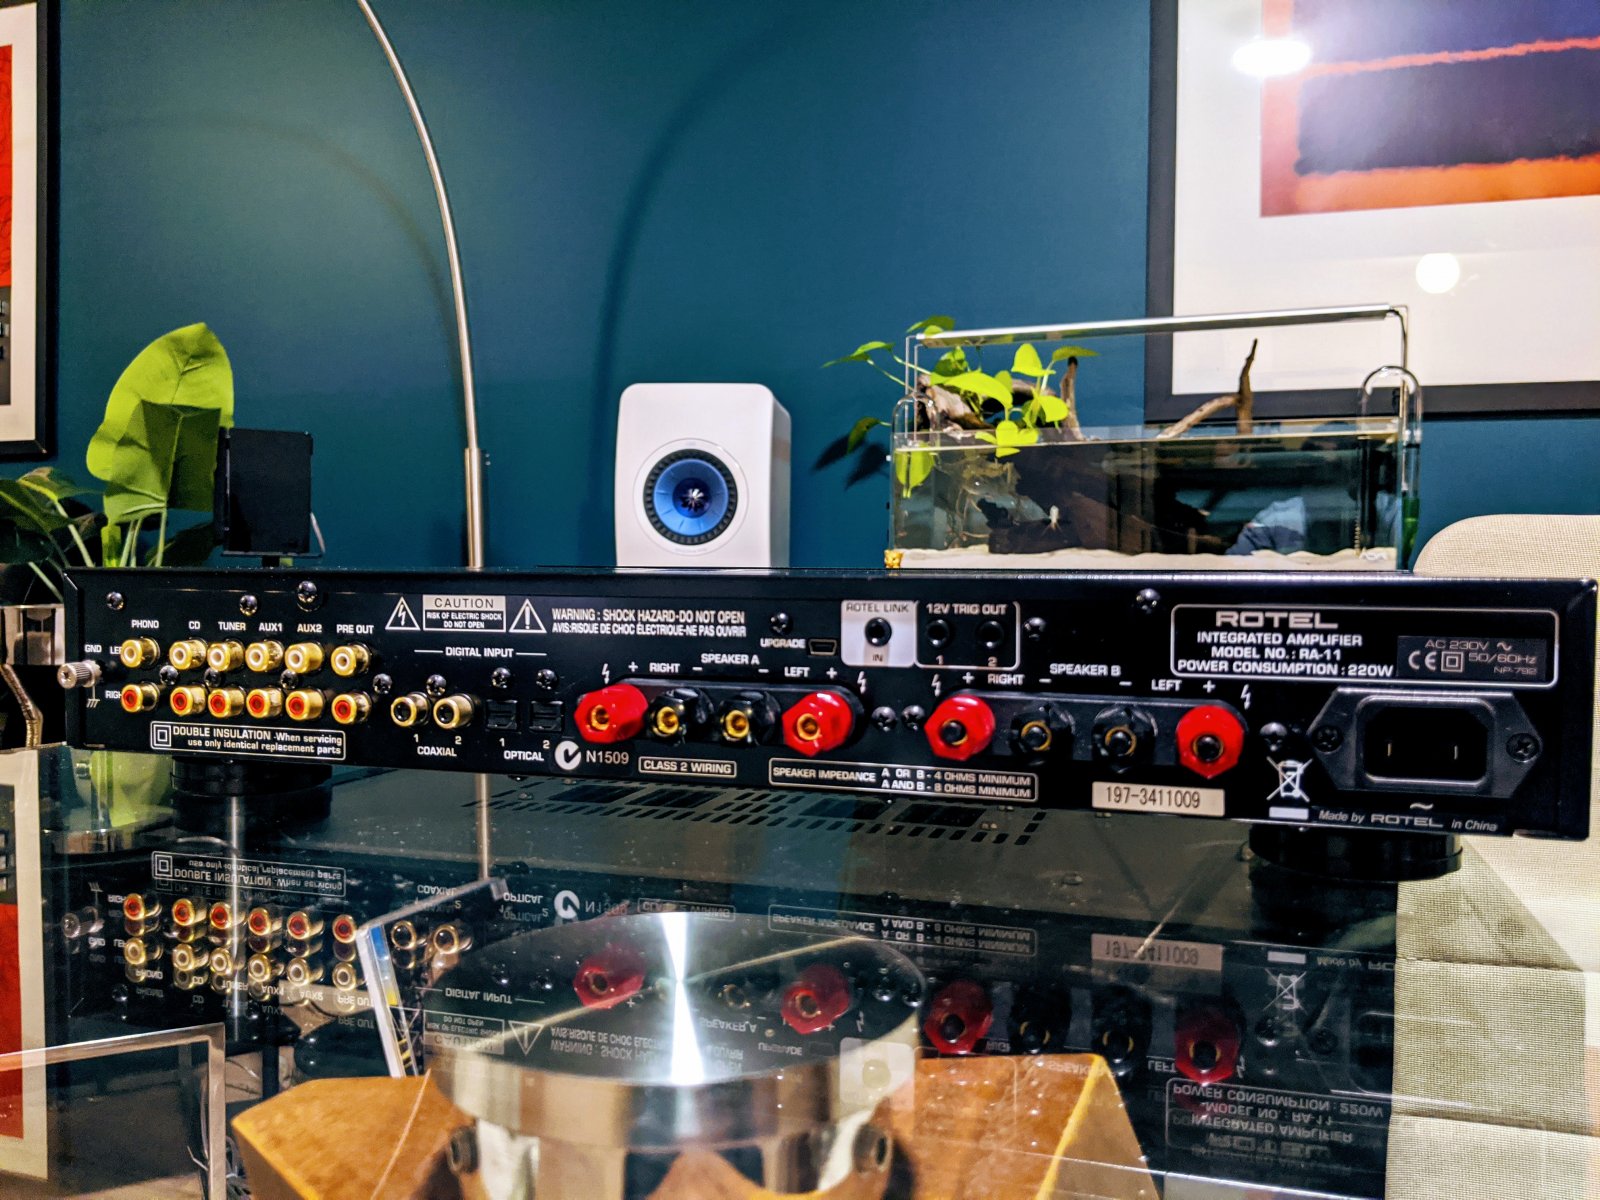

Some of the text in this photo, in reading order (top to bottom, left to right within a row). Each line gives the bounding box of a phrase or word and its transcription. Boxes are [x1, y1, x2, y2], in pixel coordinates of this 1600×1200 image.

[434, 598, 494, 609] CAUTION
[846, 603, 910, 613] ROTEL LINK
[552, 608, 596, 620] WARNING
[603, 609, 635, 622] SHOCK
[696, 610, 716, 624] NOT
[718, 611, 744, 624] OPEN
[926, 604, 1008, 616] 12V TRIG OUT
[426, 612, 502, 621] RISK OF ELECTRIC SHOCK
[1216, 610, 1338, 629] ROTEL
[131, 620, 160, 630] PHONO
[188, 620, 200, 630] CD
[218, 621, 246, 632] TUNER
[258, 622, 282, 632] AUX1
[297, 623, 322, 633] AUX2
[336, 624, 374, 634] PRE OUT
[467, 621, 484, 629] OPEN
[600, 623, 610, 634] DE
[612, 624, 635, 635] CHOC
[698, 625, 714, 636] PAS
[716, 625, 746, 638] OUVRIR
[760, 638, 806, 649] UPGRADE
[1197, 631, 1362, 646] INTEGRATED AMPLIFIER
[1424, 639, 1490, 650] AC 230V
[84, 644, 102, 653] GND
[445, 646, 514, 658] DIGITAL INPUT
[1211, 646, 1260, 659] MODEL
[1300, 648, 1342, 661] RA-11
[701, 653, 760, 665] SPEAKER A
[872, 654, 884, 663] IN
[936, 655, 944, 666] 1
[988, 656, 998, 668] 2
[1468, 652, 1538, 664] 50/60Hz
[649, 662, 680, 673] RIGHT
[784, 666, 810, 678] LEFT
[1050, 663, 1122, 676] SPEAKER B
[1178, 659, 1229, 672] POWER
[1232, 661, 1338, 676] CONSUMPTION
[1348, 664, 1394, 677] 220W
[987, 674, 1025, 686] RIGHT
[1152, 679, 1182, 692] LEFT
[173, 726, 210, 737] DOUBLE
[213, 728, 271, 740] INSULATION
[303, 734, 342, 746] servicing
[414, 734, 420, 743] 1
[455, 736, 462, 745] 2
[188, 739, 342, 756] use only identical replacement parts
[500, 738, 506, 747] 1
[542, 740, 550, 749] 2
[416, 746, 457, 757] COAXIAL
[503, 750, 545, 762] OPTICAL
[586, 750, 630, 764] N1509
[643, 760, 732, 774] CLASS 2 WIRING
[772, 766, 876, 783] SPEAKER IMPEDANCE
[881, 768, 890, 778] A
[895, 768, 912, 779] OR
[916, 769, 924, 780] B
[934, 770, 942, 780] 4
[944, 772, 976, 783] OHMS
[978, 774, 1032, 786] MINIMUM
[881, 779, 890, 789] A
[891, 780, 914, 791] AND
[916, 781, 924, 792] B
[944, 784, 976, 795] OHMS
[978, 786, 1032, 798] MINIMUM
[1106, 786, 1200, 808] 197-3411009
[1318, 810, 1498, 832] Made by ROTEL in China
